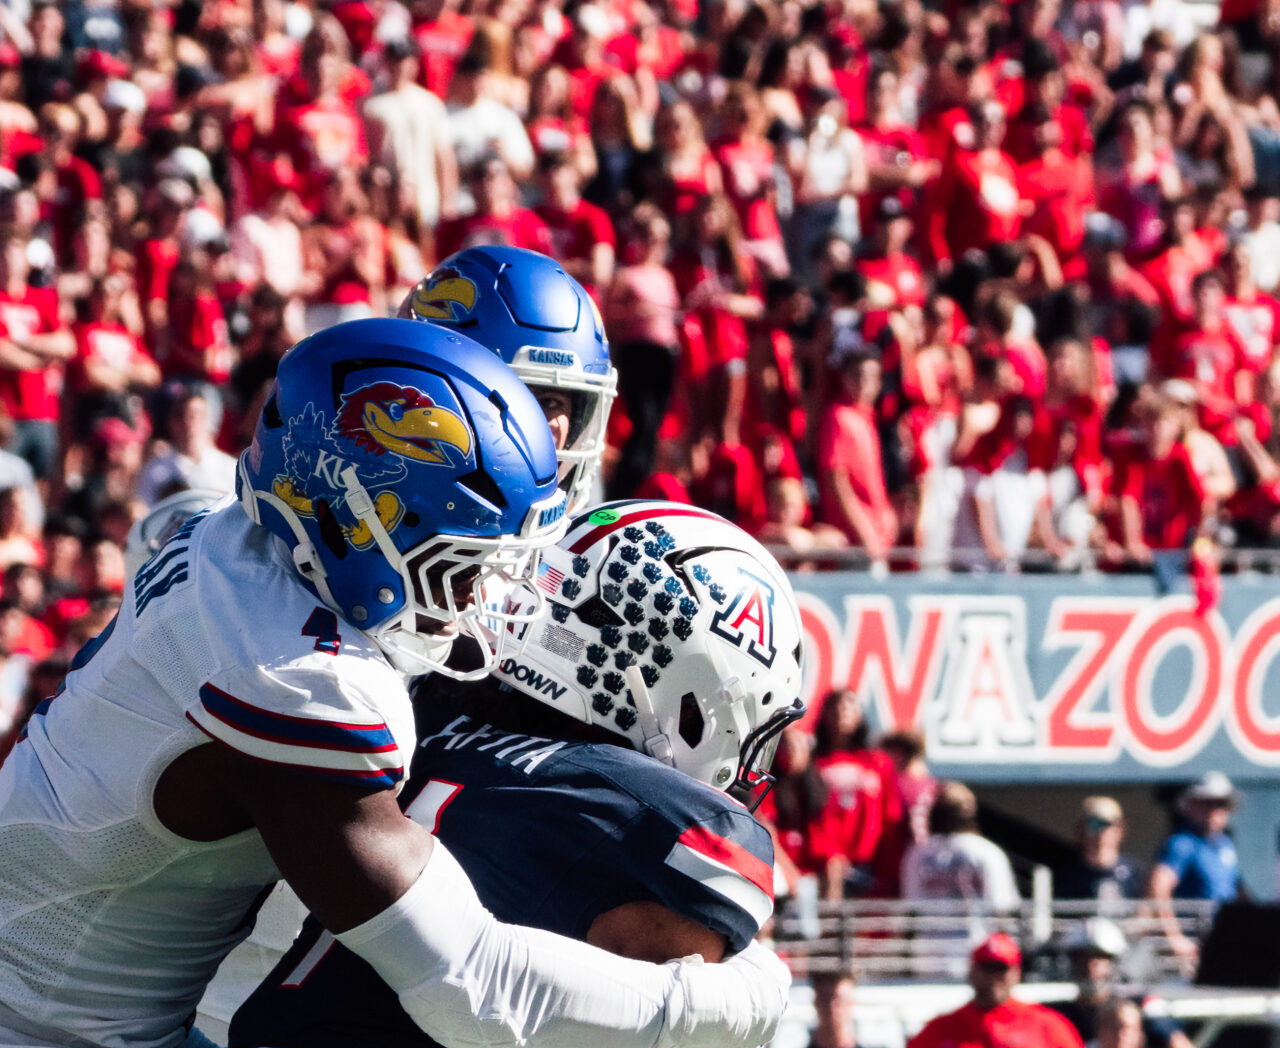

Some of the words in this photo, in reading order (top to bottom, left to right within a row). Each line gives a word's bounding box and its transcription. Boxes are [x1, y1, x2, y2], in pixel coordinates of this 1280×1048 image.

[528, 348, 575, 367] KANSAS
[709, 566, 777, 670] A
[501, 658, 568, 701] DOWN
